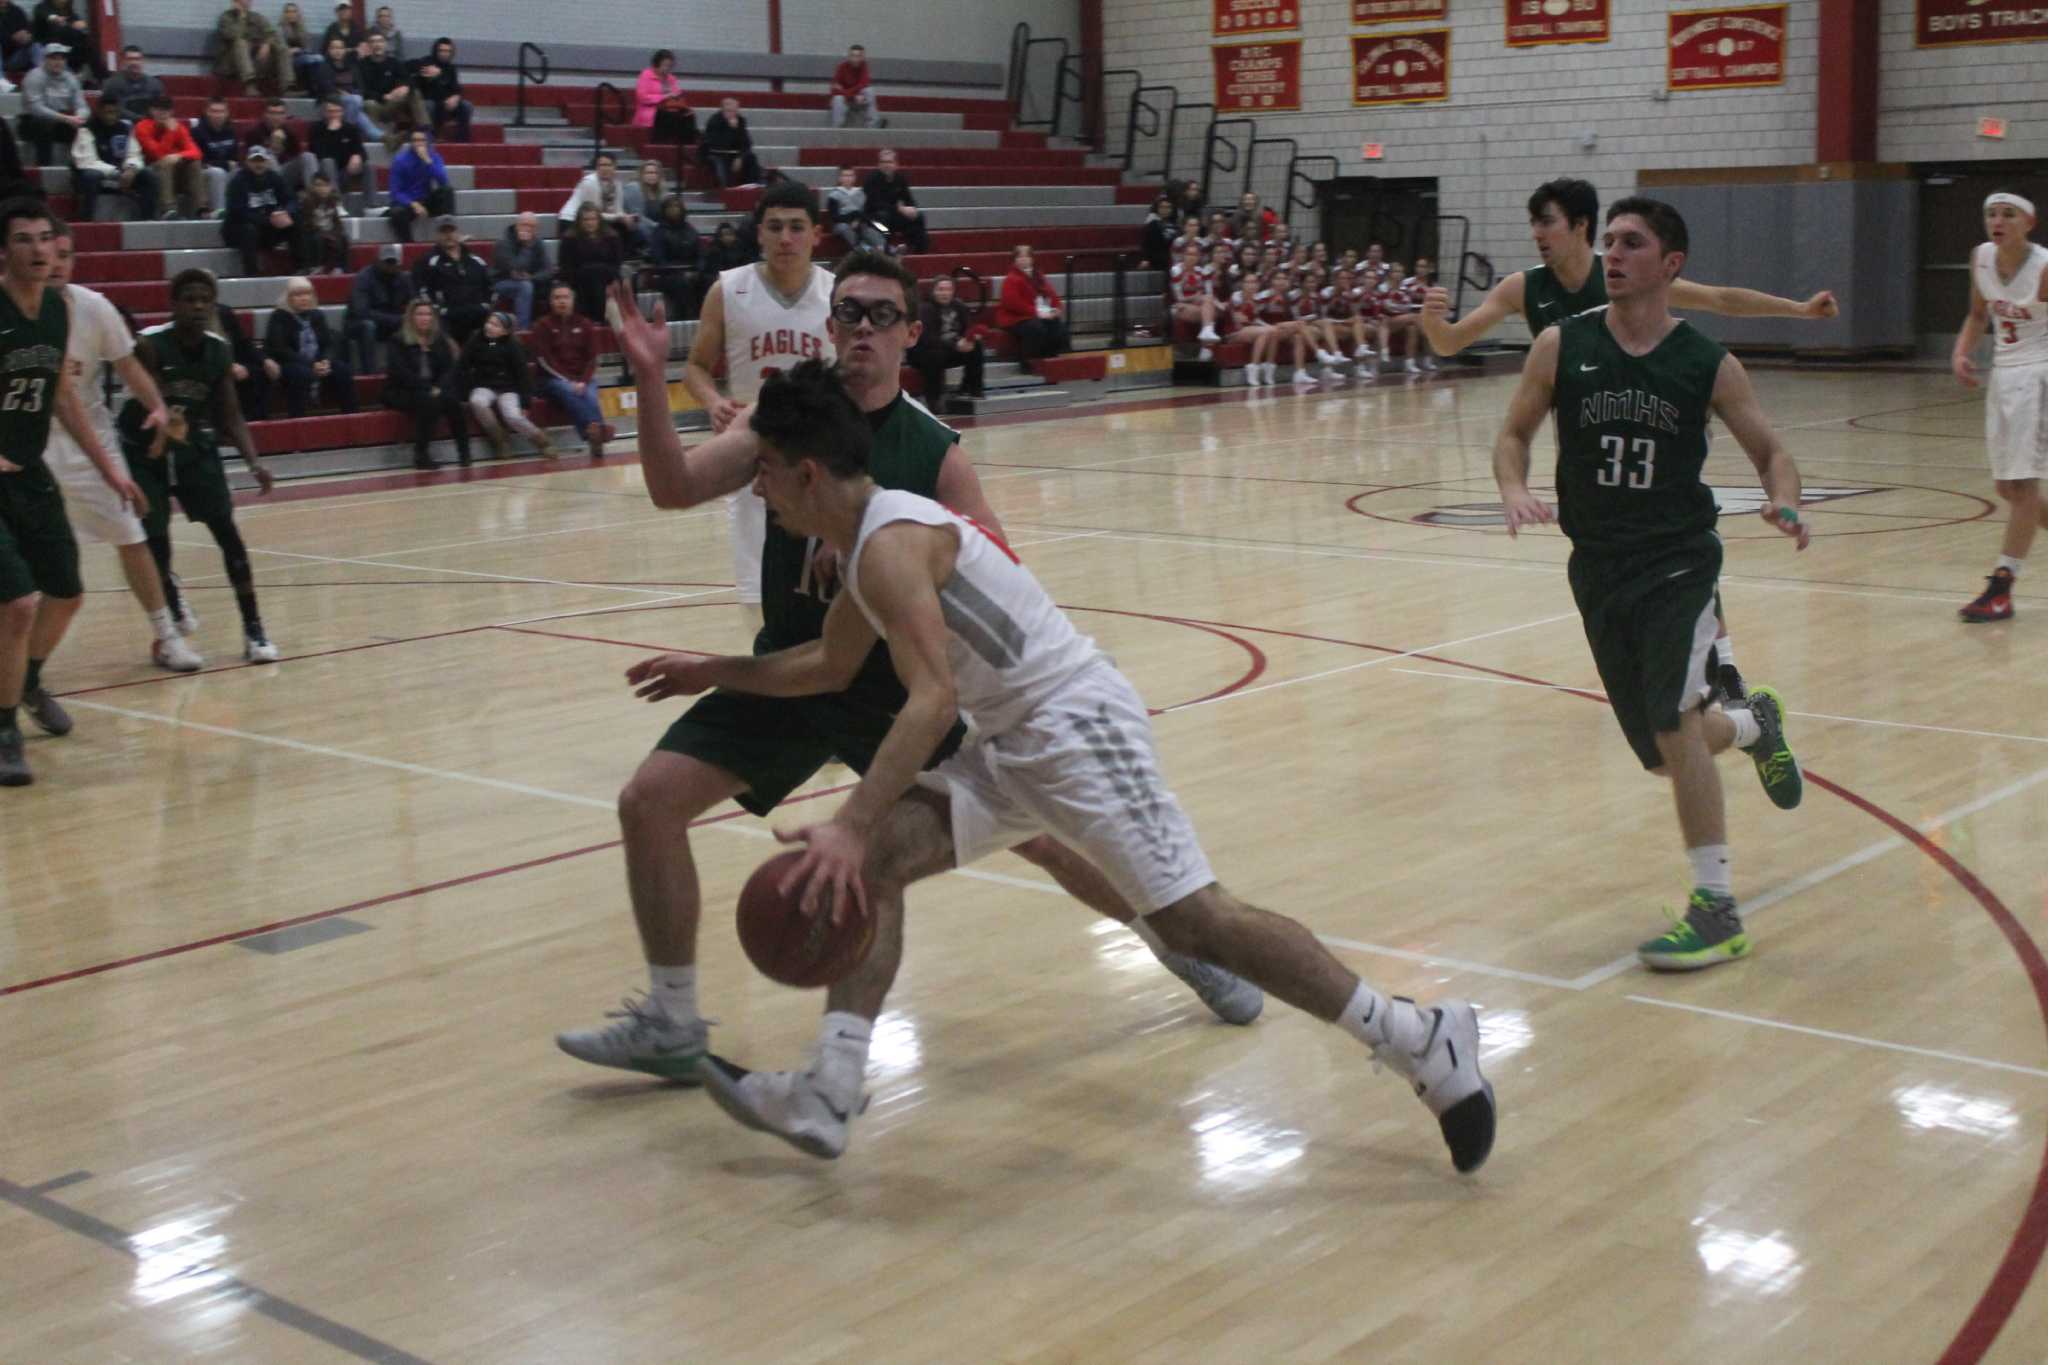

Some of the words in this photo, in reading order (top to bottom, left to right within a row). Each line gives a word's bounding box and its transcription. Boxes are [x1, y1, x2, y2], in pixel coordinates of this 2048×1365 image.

[1928, 13, 1983, 32] BOYS
[751, 329, 823, 361] EAGLES
[2001, 321, 2018, 344] 3
[2, 377, 46, 412] 23
[1579, 389, 1679, 435] NMHS
[1597, 434, 1656, 489] 33
